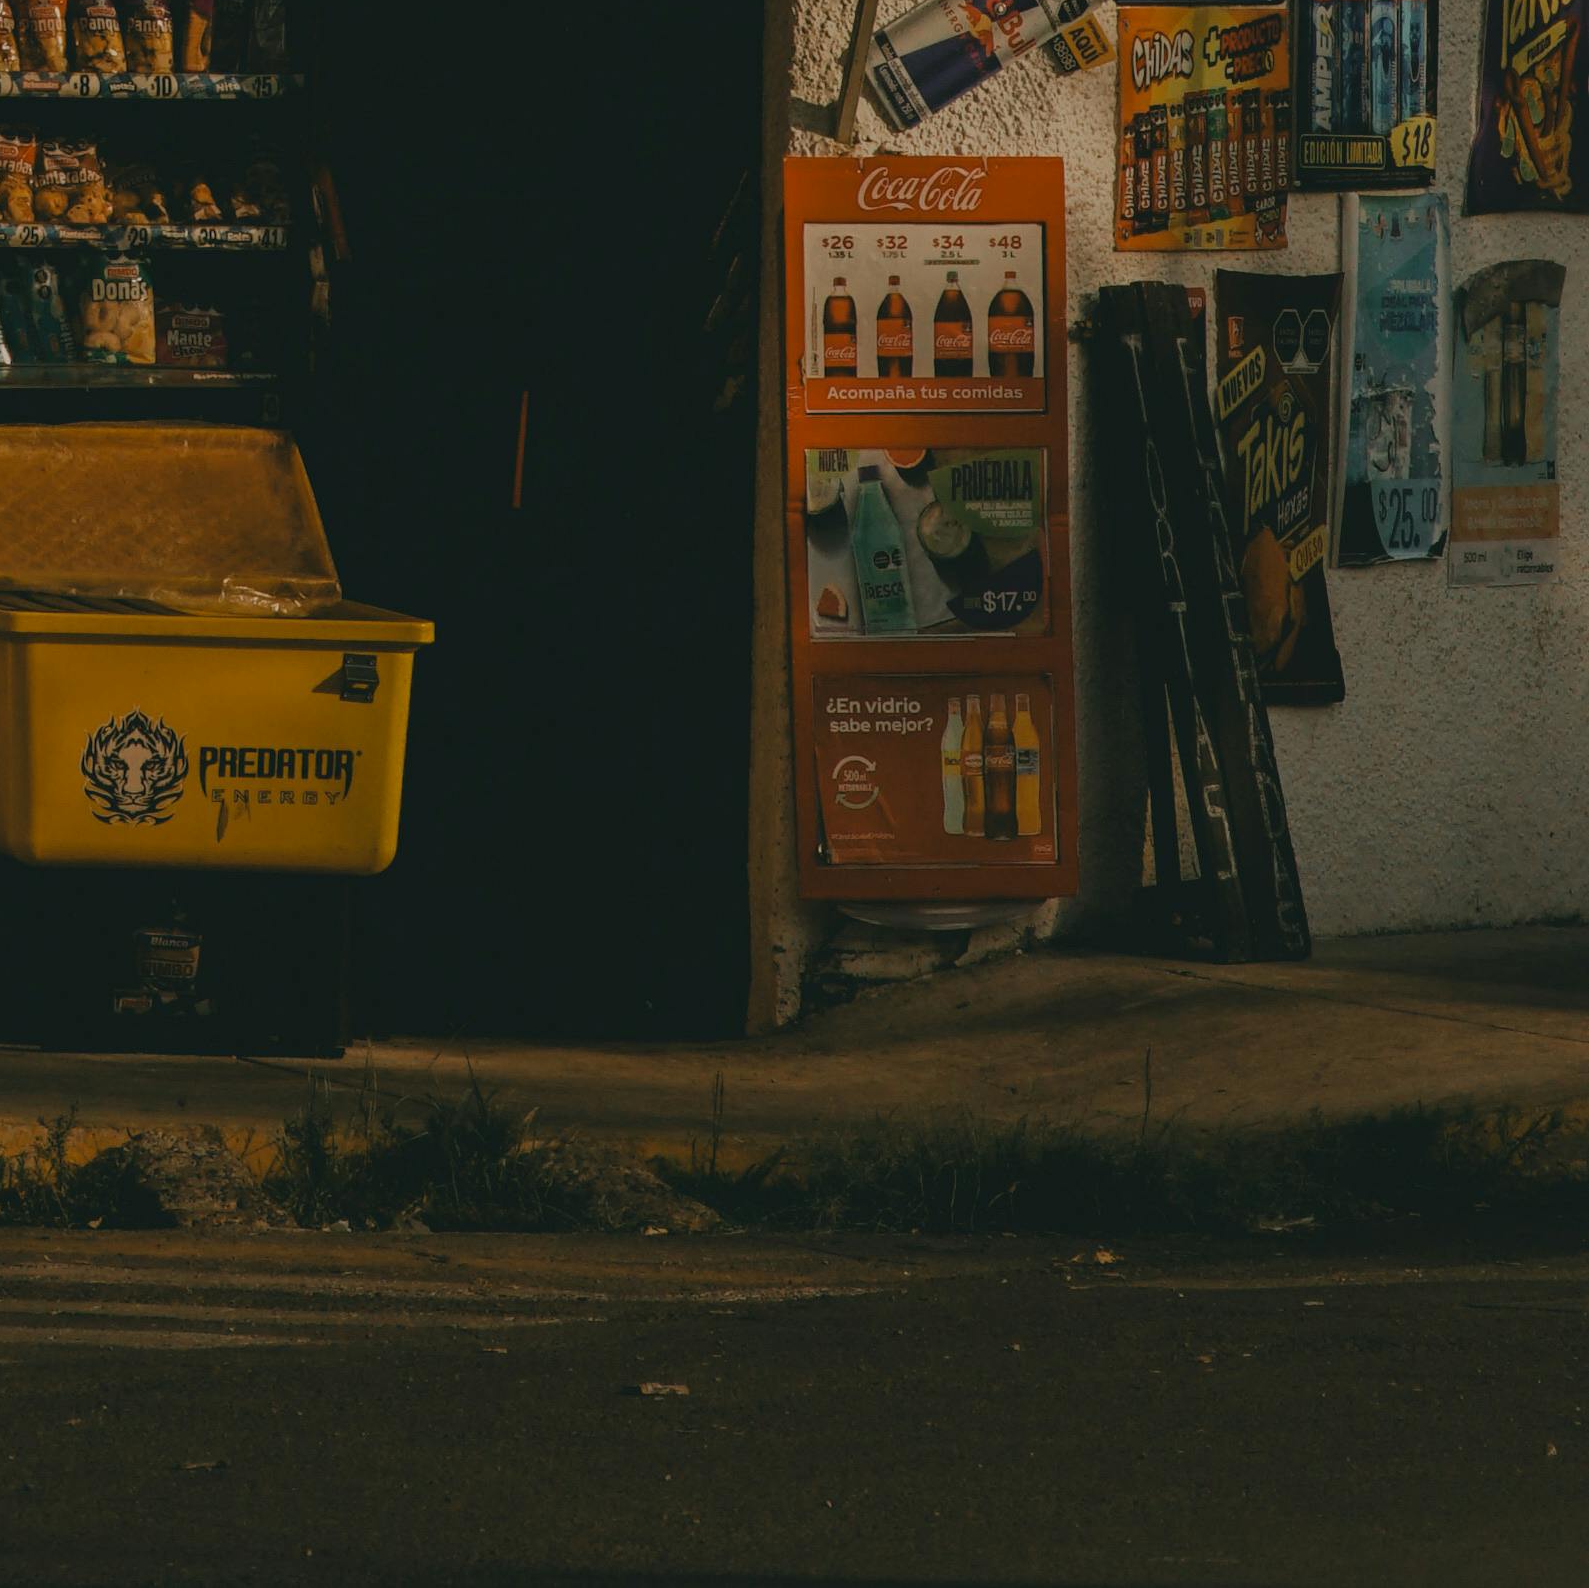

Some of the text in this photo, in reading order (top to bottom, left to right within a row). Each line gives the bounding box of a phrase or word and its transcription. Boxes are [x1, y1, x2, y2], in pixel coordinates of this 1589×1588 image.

[998, 10, 1037, 58] Bull
[1402, 120, 1433, 162] $18
[857, 166, 989, 212] Coca-Cola
[821, 234, 855, 251] $26
[876, 234, 909, 251] $32
[931, 234, 965, 250] $34
[988, 234, 1023, 250] $48
[848, 251, 855, 259] L
[900, 251, 908, 259] L
[1002, 250, 1009, 259] 3
[91, 278, 149, 302] Donas
[1222, 351, 1263, 412] NUEVOS
[826, 385, 1025, 403] Acompaña tus comidas
[951, 457, 1033, 502] PRUÉBALA
[825, 696, 921, 715] ¿En vidrio
[829, 716, 934, 735] sabe mejor?
[199, 746, 357, 800] PREDATOR
[212, 788, 344, 806] ENERGY
[150, 935, 189, 948] Blanco
